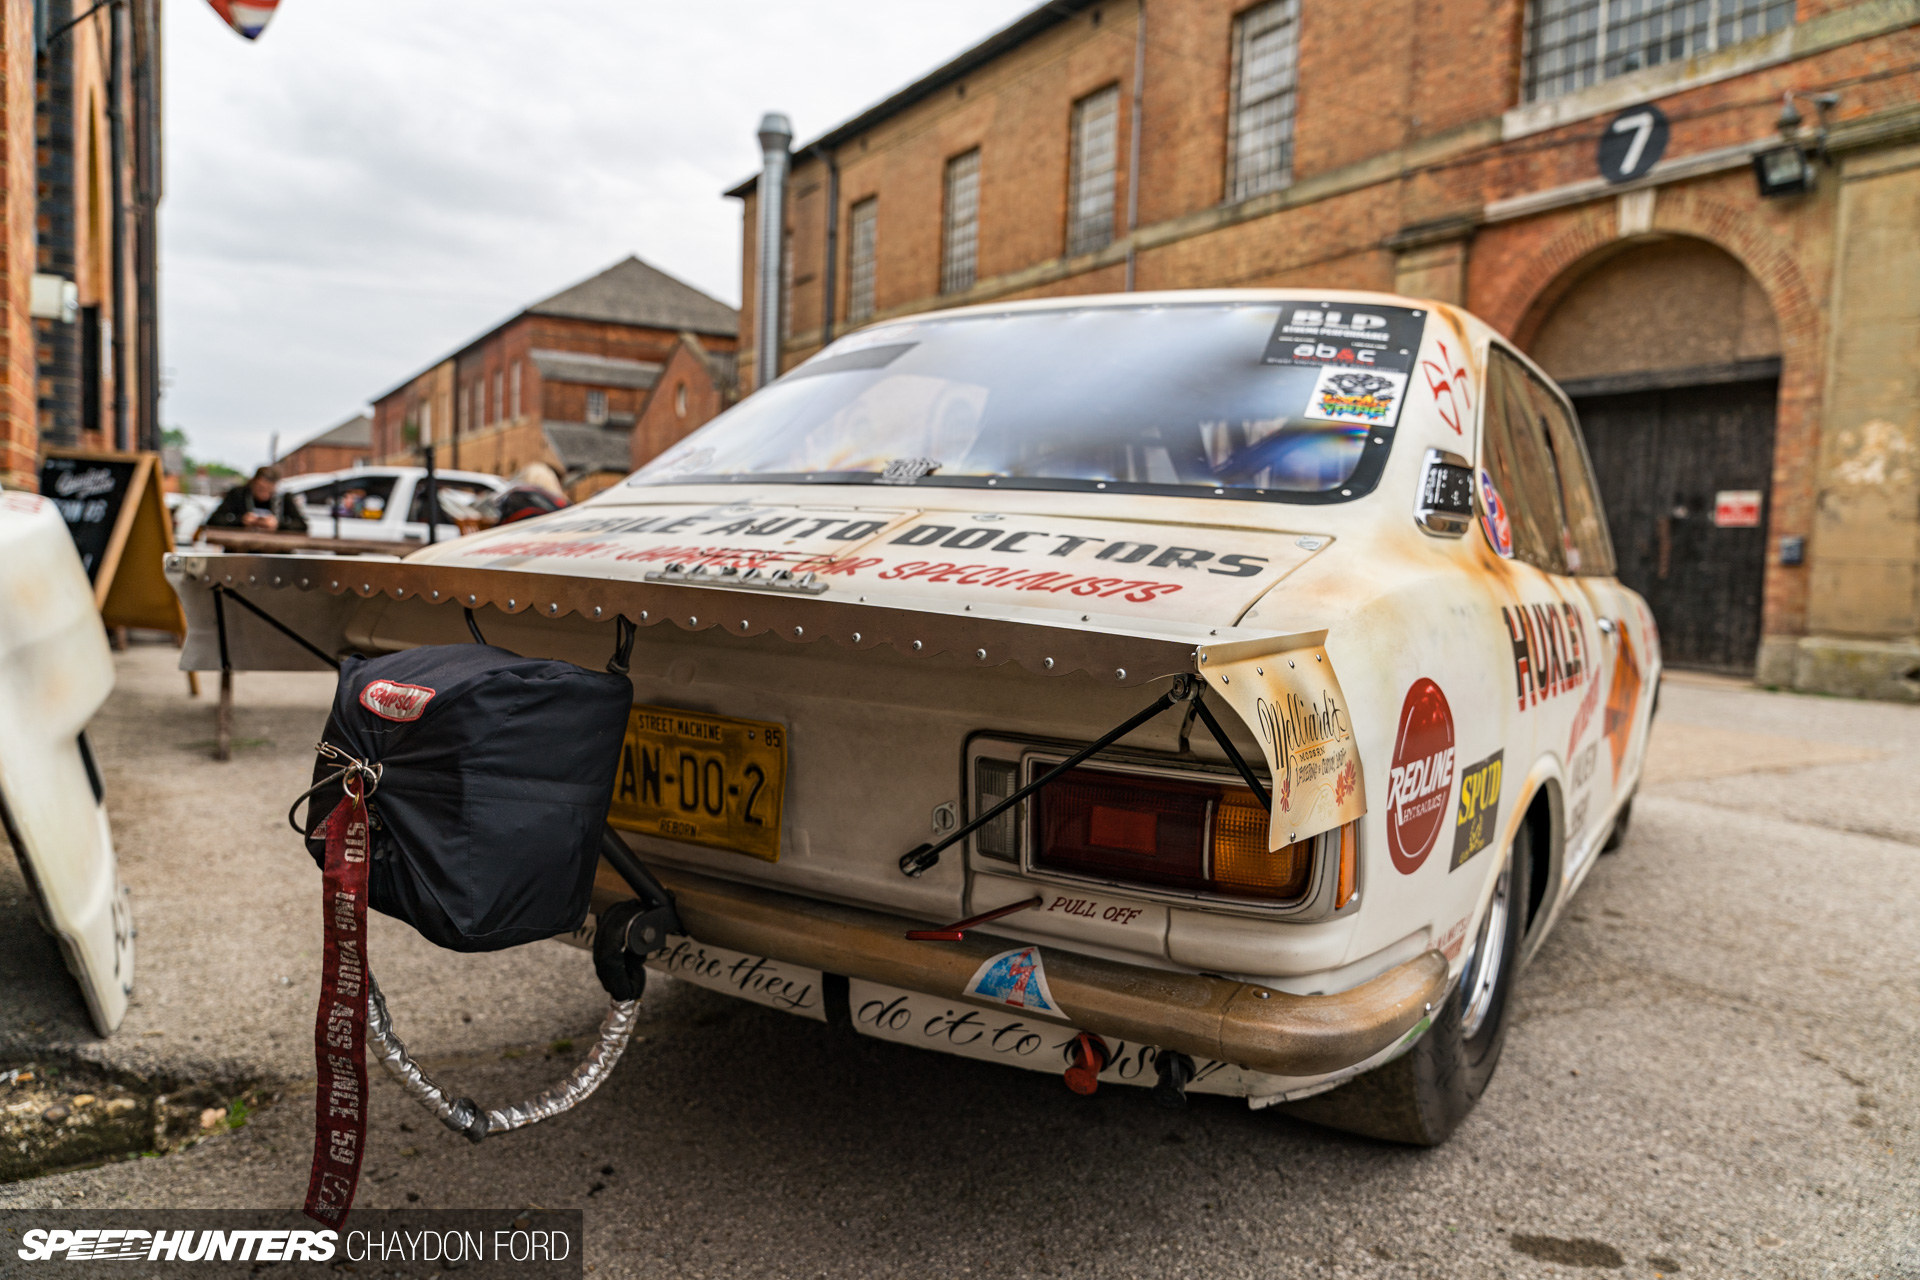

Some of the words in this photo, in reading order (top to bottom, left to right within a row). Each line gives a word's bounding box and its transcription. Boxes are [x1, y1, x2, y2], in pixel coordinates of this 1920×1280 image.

[1612, 111, 1655, 175] 7
[703, 516, 889, 541] AUTO
[888, 524, 1270, 577] DOCTORS
[791, 554, 883, 577] CAR
[878, 560, 1184, 603] SPECIALISTS
[638, 714, 674, 733] STREET
[677, 721, 721, 741] MACHINE
[765, 729, 781, 747] 85
[1298, 745, 1326, 762] MODERN
[619, 744, 764, 827] AN-DO-2
[1387, 746, 1455, 826] REDLINE
[1457, 759, 1502, 827] SPUD
[660, 819, 697, 837] REBORN
[1047, 896, 1097, 919] PULL
[1102, 906, 1143, 926] OFF
[336, 939, 362, 997] YOUR
[327, 1001, 354, 1050] ASS
[646, 941, 722, 978] efore
[728, 957, 816, 1009] they
[857, 996, 912, 1030] do
[923, 1009, 984, 1045] it
[992, 1022, 1043, 1056] to
[327, 1053, 360, 1121] SINCE
